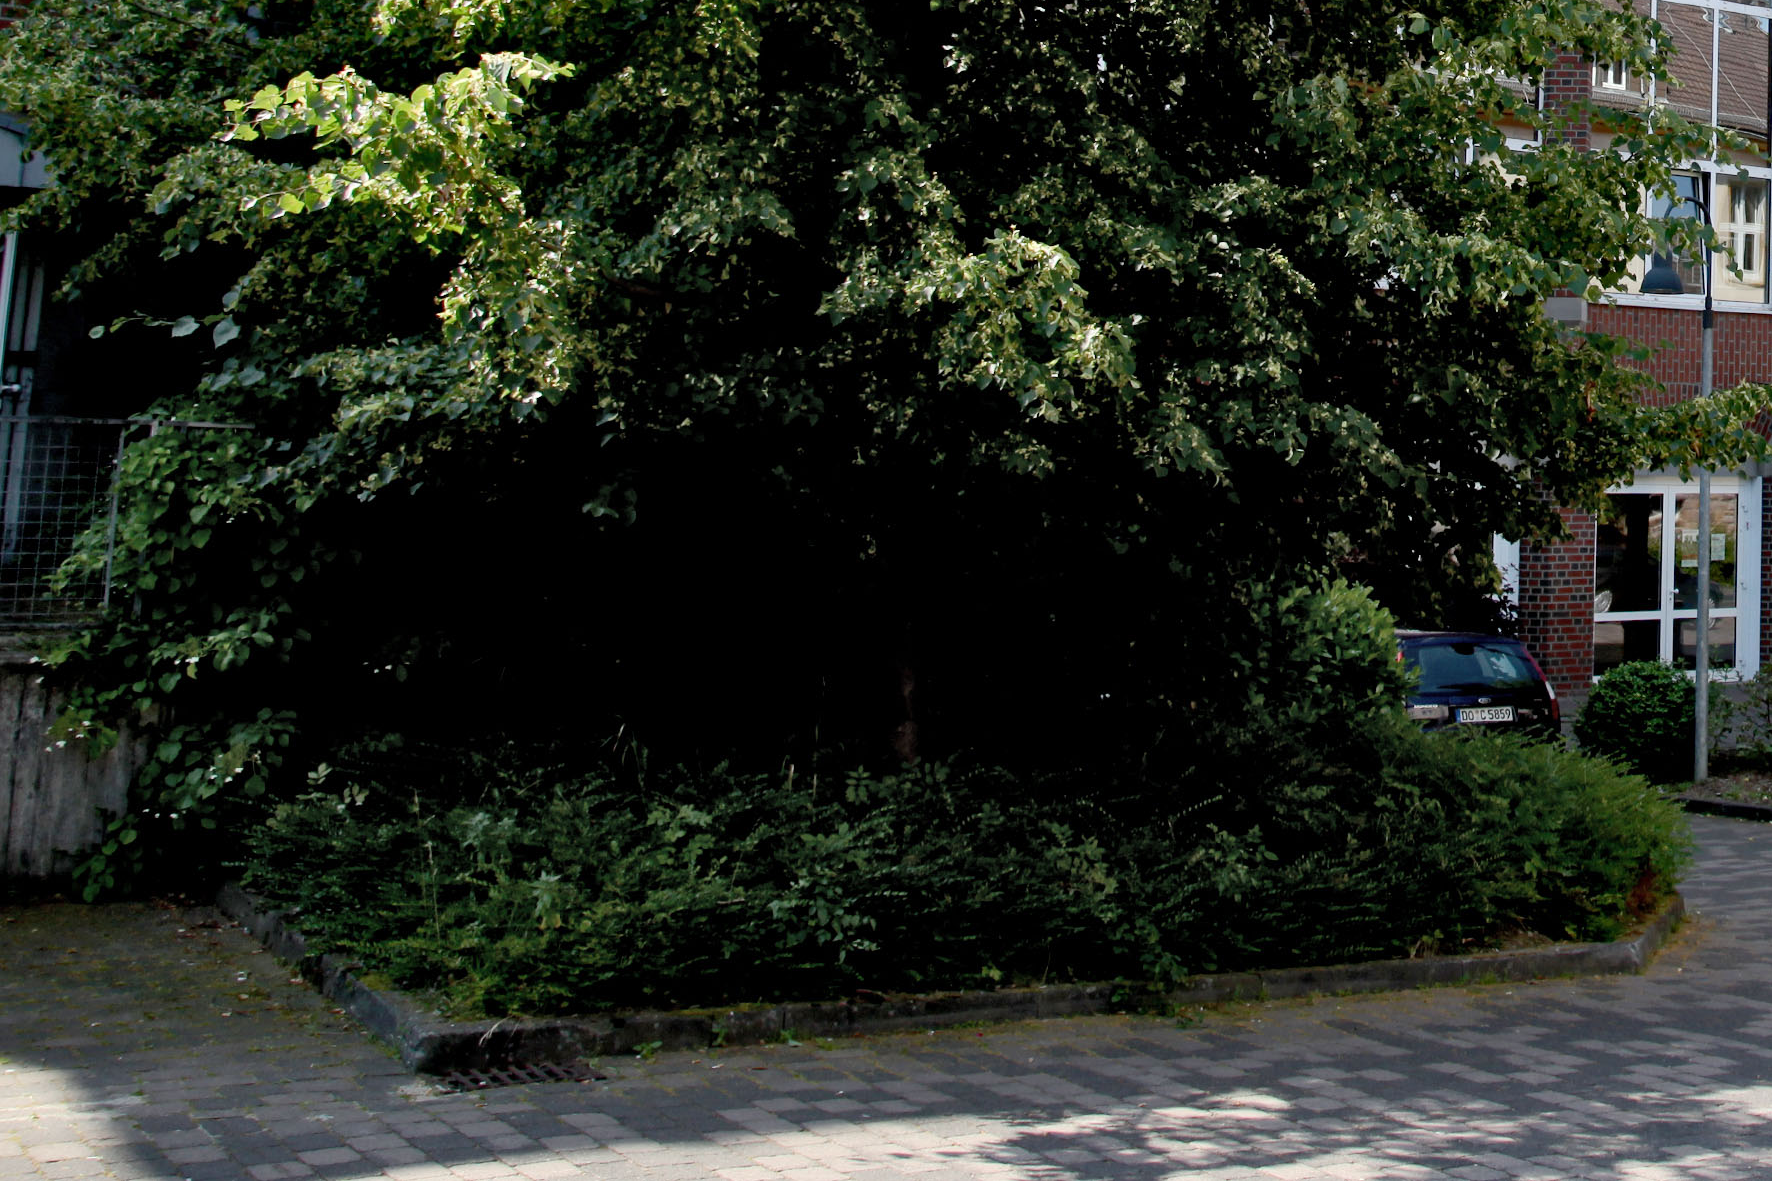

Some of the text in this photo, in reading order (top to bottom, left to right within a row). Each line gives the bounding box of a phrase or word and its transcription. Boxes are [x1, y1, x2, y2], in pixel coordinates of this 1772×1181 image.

[1461, 708, 1511, 720] DO C 5859
